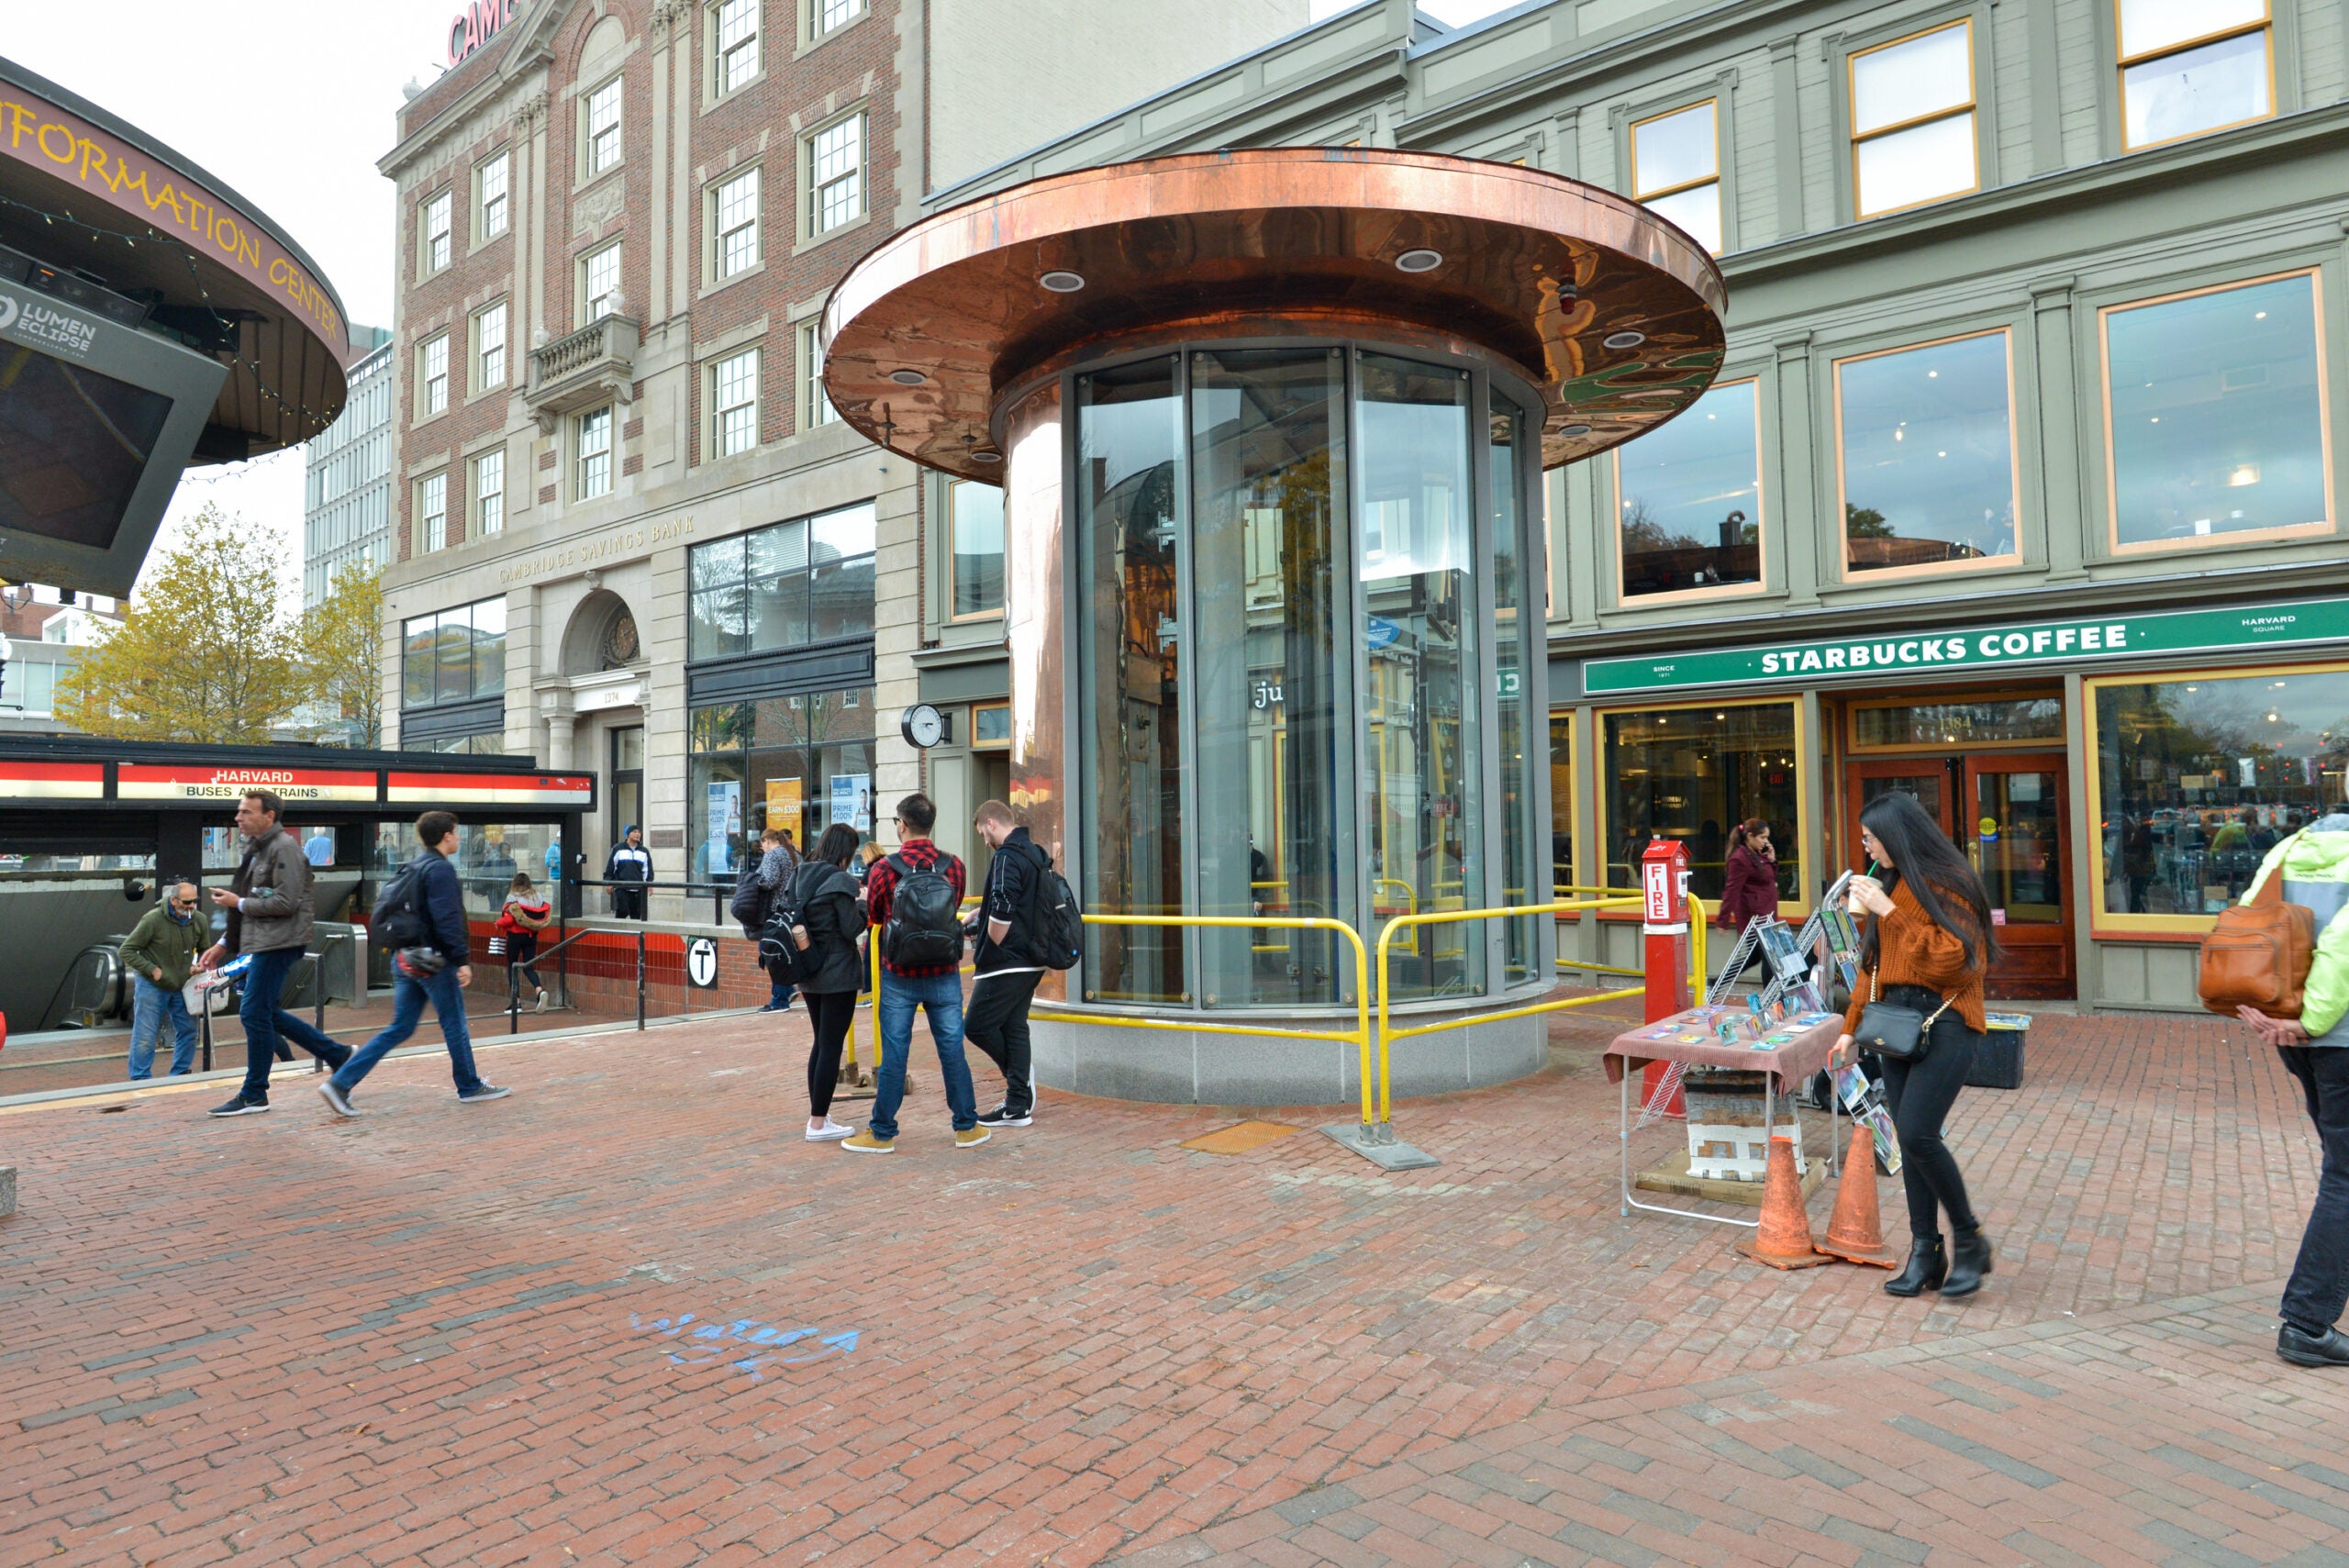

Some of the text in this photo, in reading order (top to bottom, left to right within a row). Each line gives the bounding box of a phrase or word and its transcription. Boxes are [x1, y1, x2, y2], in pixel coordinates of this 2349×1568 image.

[0, 101, 337, 340] FORMATION CENTER
[17, 317, 90, 351] ECLIPSE
[22, 303, 96, 339] LUMEN
[498, 515, 694, 584] CAMBRIDGE SAVINGS BANK
[2242, 615, 2296, 626] HARVARD
[2253, 625, 2286, 633] SQUARE
[1762, 625, 2127, 673] STARBUCKS COFFEE
[186, 786, 232, 796] BUSES
[272, 787, 318, 797] TRAINS
[216, 770, 294, 783] HARVARD
[833, 804, 852, 812] PRIME
[1652, 865, 1664, 917] FIRE
[695, 950, 710, 980] T
